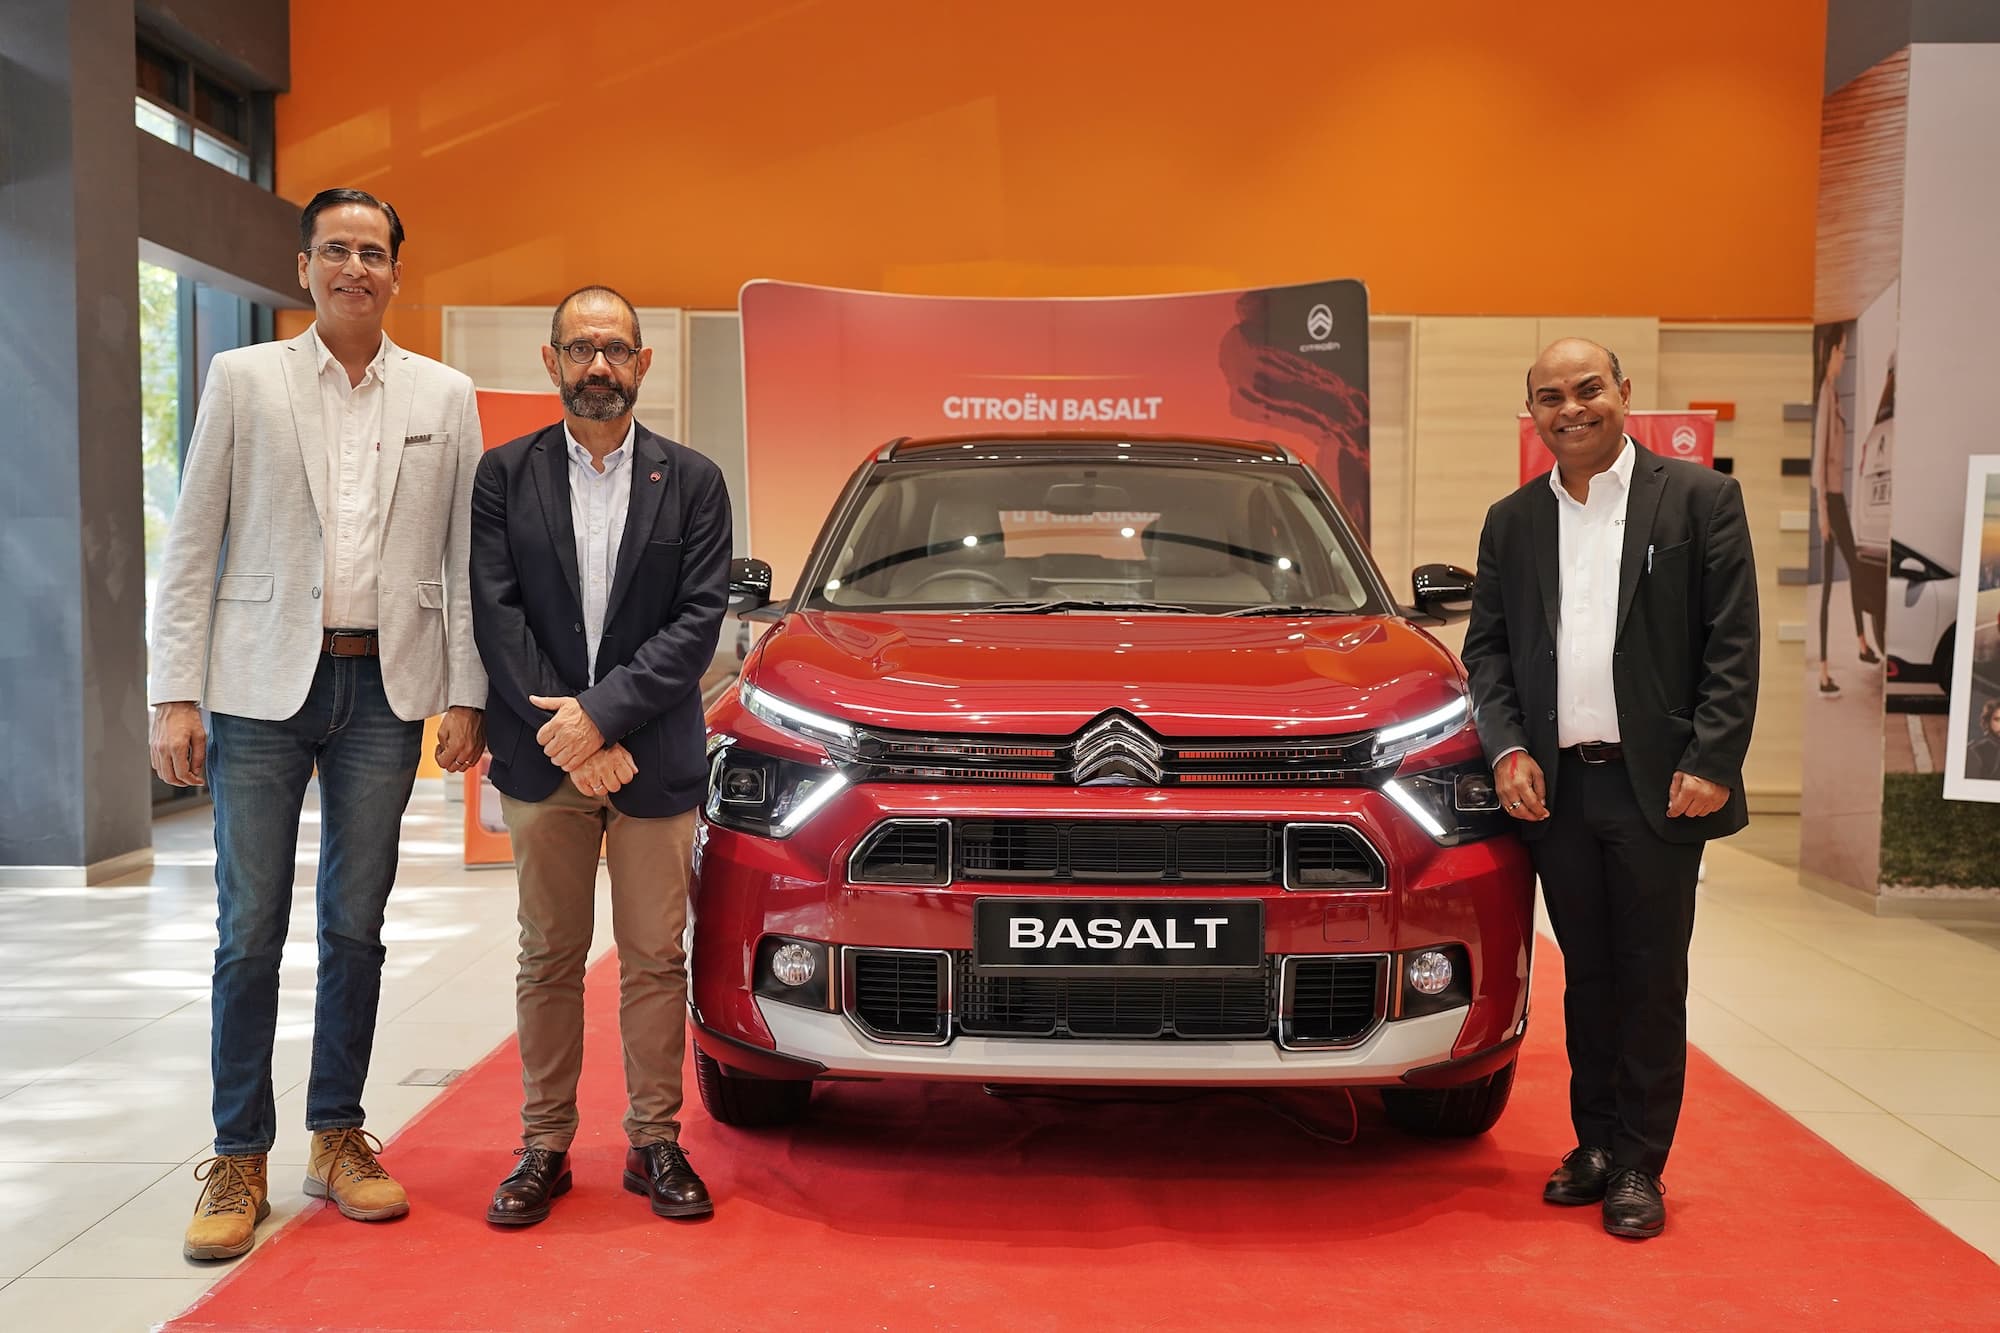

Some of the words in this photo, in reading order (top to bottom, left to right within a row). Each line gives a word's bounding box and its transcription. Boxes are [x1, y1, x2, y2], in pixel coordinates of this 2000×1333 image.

[943, 392, 1057, 421] CITROËN
[1062, 397, 1163, 421] BASALT
[1009, 918, 1229, 949] BASALT
